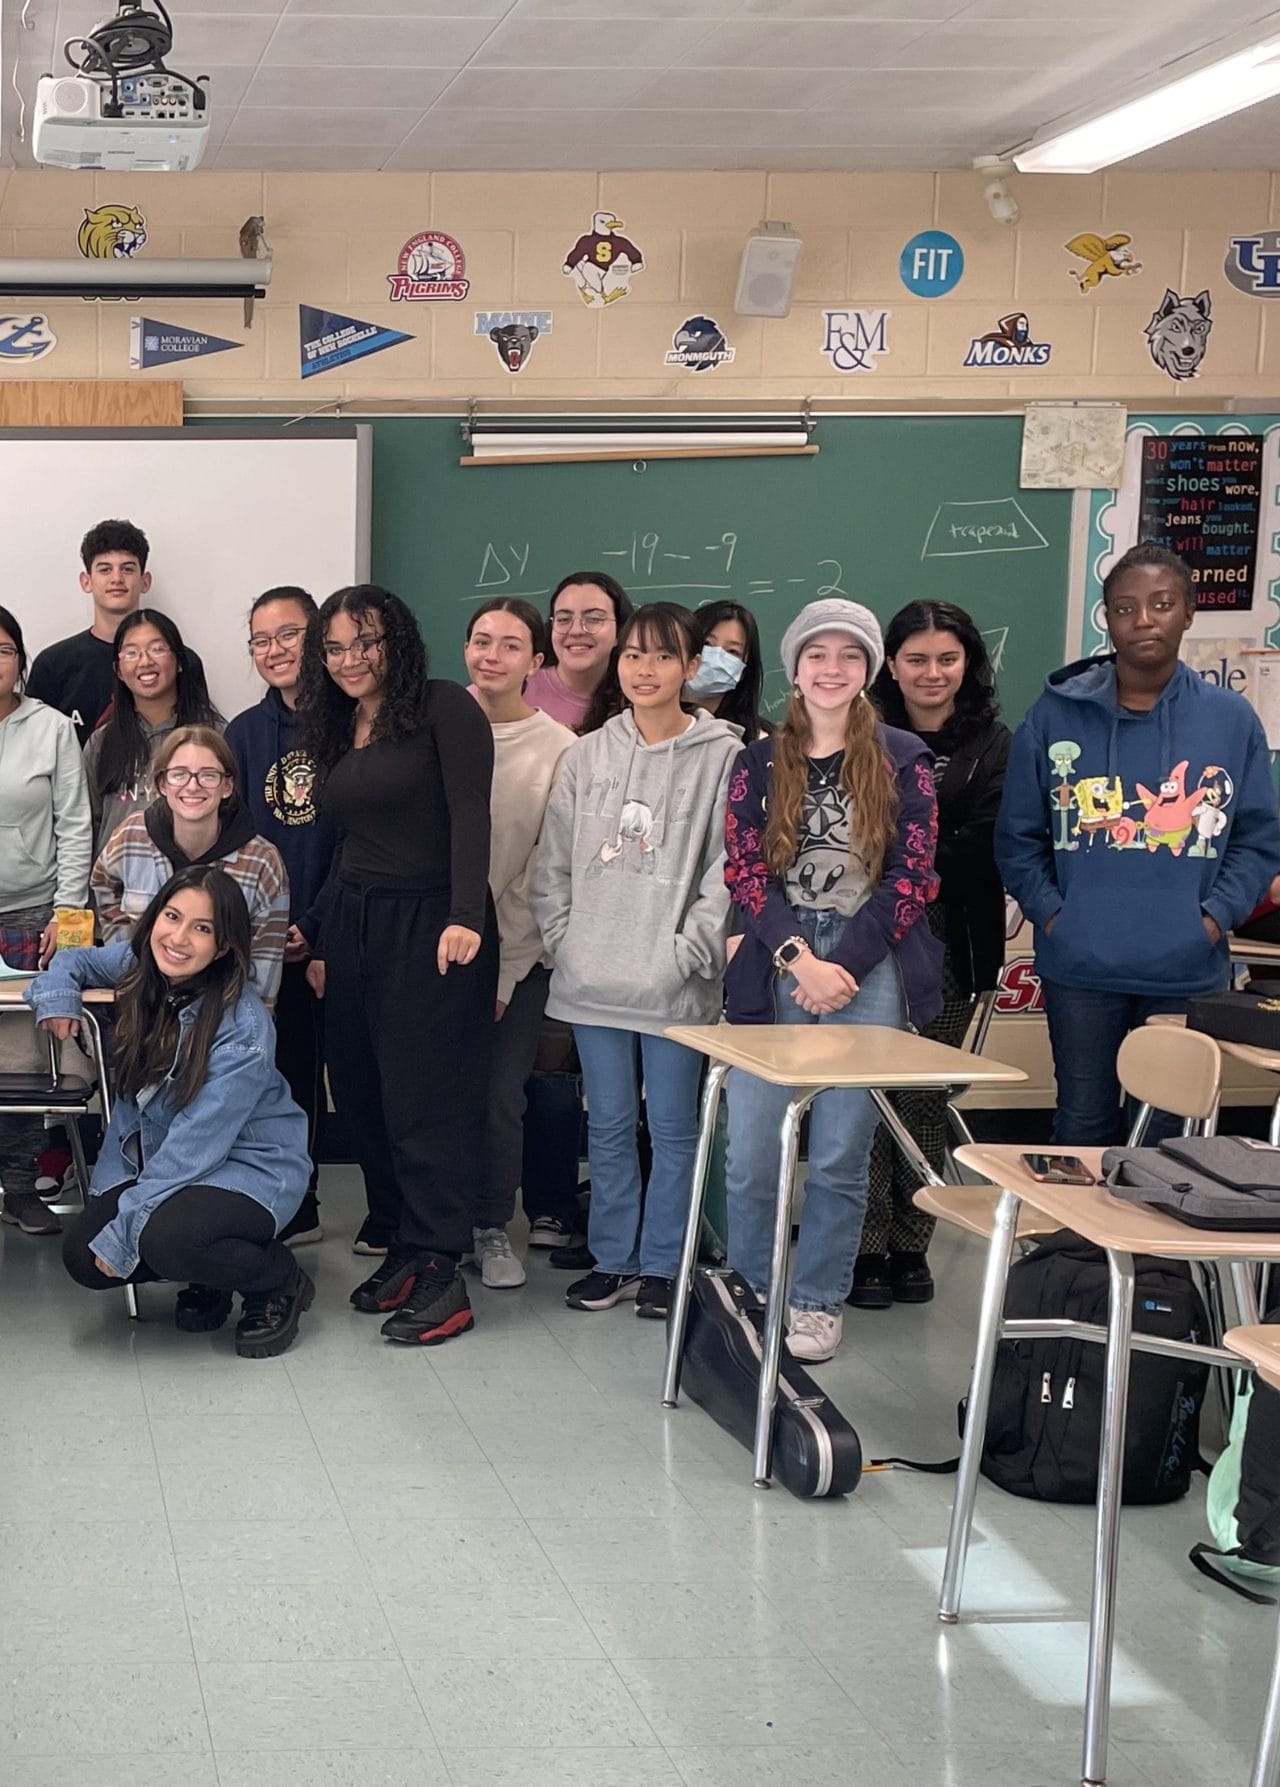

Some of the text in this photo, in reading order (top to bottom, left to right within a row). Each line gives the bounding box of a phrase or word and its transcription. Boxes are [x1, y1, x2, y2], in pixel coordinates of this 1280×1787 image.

[408, 234, 446, 251] ENGLAND
[596, 242, 612, 263] S
[913, 248, 953, 281] FIT
[388, 276, 466, 299] PILGRIMS
[477, 312, 551, 334] MAINE
[161, 336, 208, 345] MORAVIAN
[161, 344, 200, 352] COLLEGE
[824, 313, 888, 370] F&M
[1147, 441, 1168, 460] 30
[1170, 441, 1207, 453] years
[1228, 441, 1260, 454] now,
[1169, 458, 1205, 470] won't
[1207, 460, 1258, 472] matter
[1166, 475, 1221, 492] shoes
[1225, 485, 1260, 496] wore,
[1181, 498, 1216, 511] hair
[1165, 513, 1202, 527] jeans
[1202, 522, 1255, 536] bought.
[1175, 536, 1204, 551] will
[1206, 545, 1252, 556] matter
[1191, 564, 1248, 583] arned
[1197, 588, 1237, 604] used
